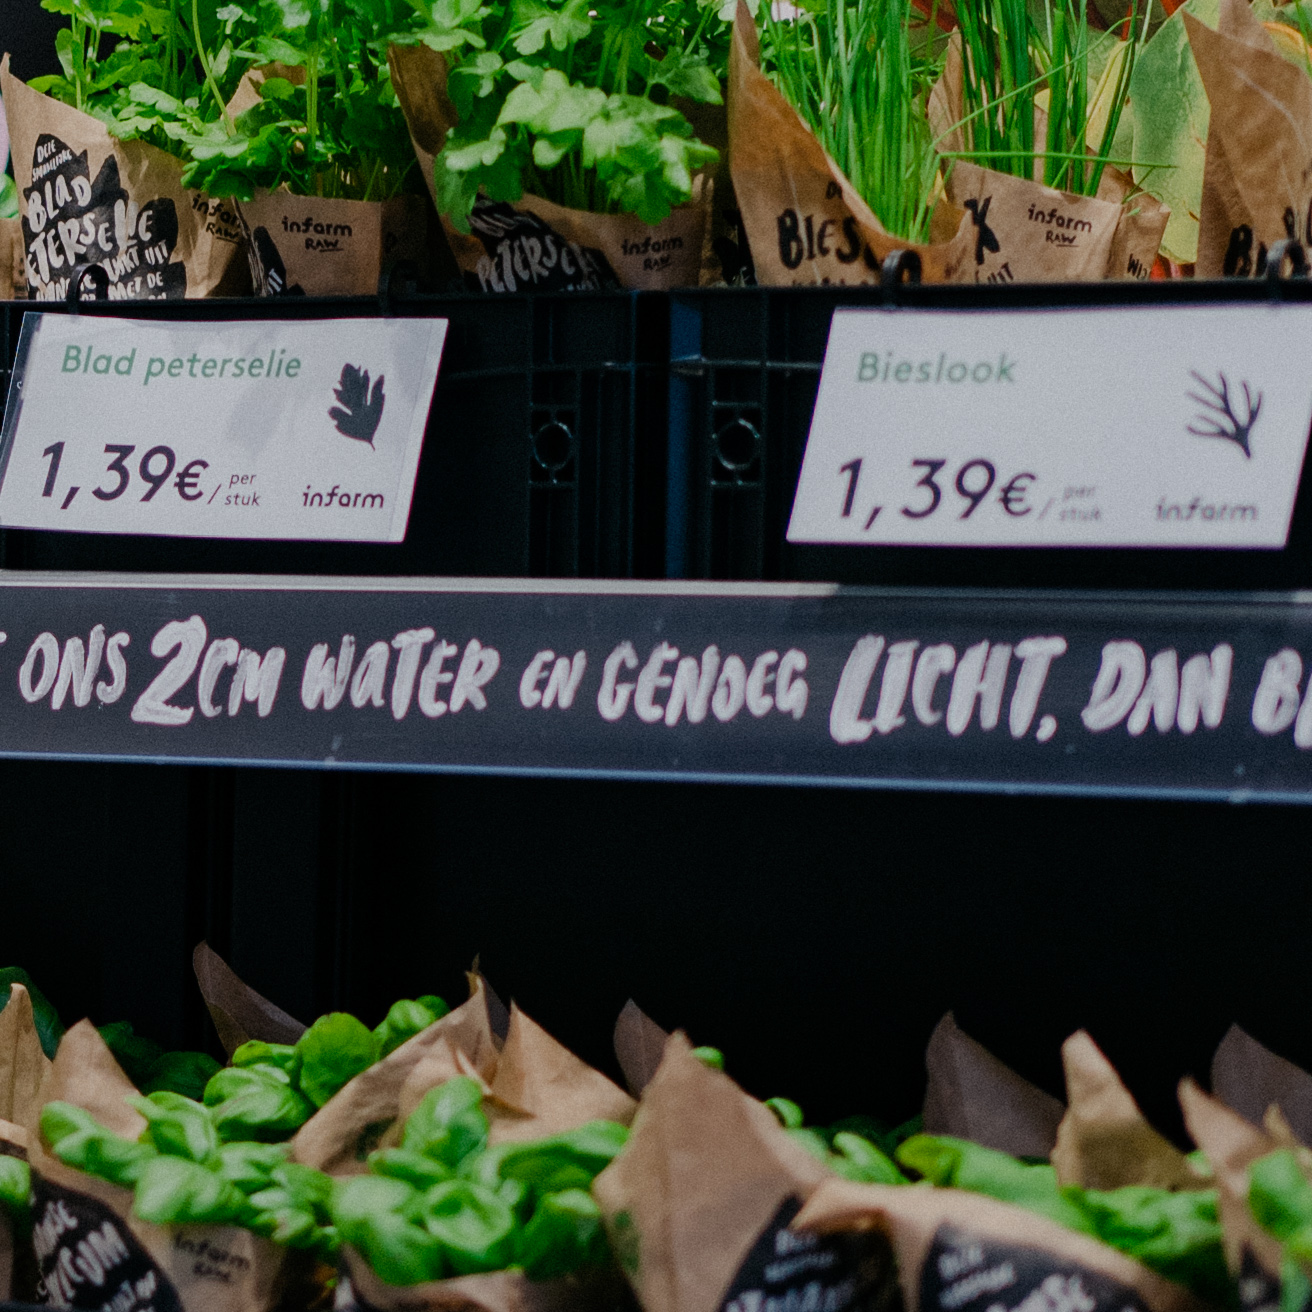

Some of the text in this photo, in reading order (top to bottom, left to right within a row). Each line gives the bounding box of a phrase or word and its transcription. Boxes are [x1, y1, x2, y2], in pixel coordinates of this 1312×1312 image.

[281, 214, 354, 238] infarm
[1027, 202, 1093, 234] infarm
[303, 237, 344, 254] RAW
[61, 344, 302, 386] Blad peterselie
[856, 351, 1017, 385] Bieslook
[229, 471, 257, 488] per
[224, 491, 261, 507] stuk
[302, 484, 386, 509] infarm
[18, 622, 131, 711] ONS
[301, 625, 501, 722] WATER
[518, 649, 587, 710] EN
[596, 639, 810, 728] GENOEG
[829, 633, 1069, 745] LICHT.
[1080, 639, 1234, 737] DAN
